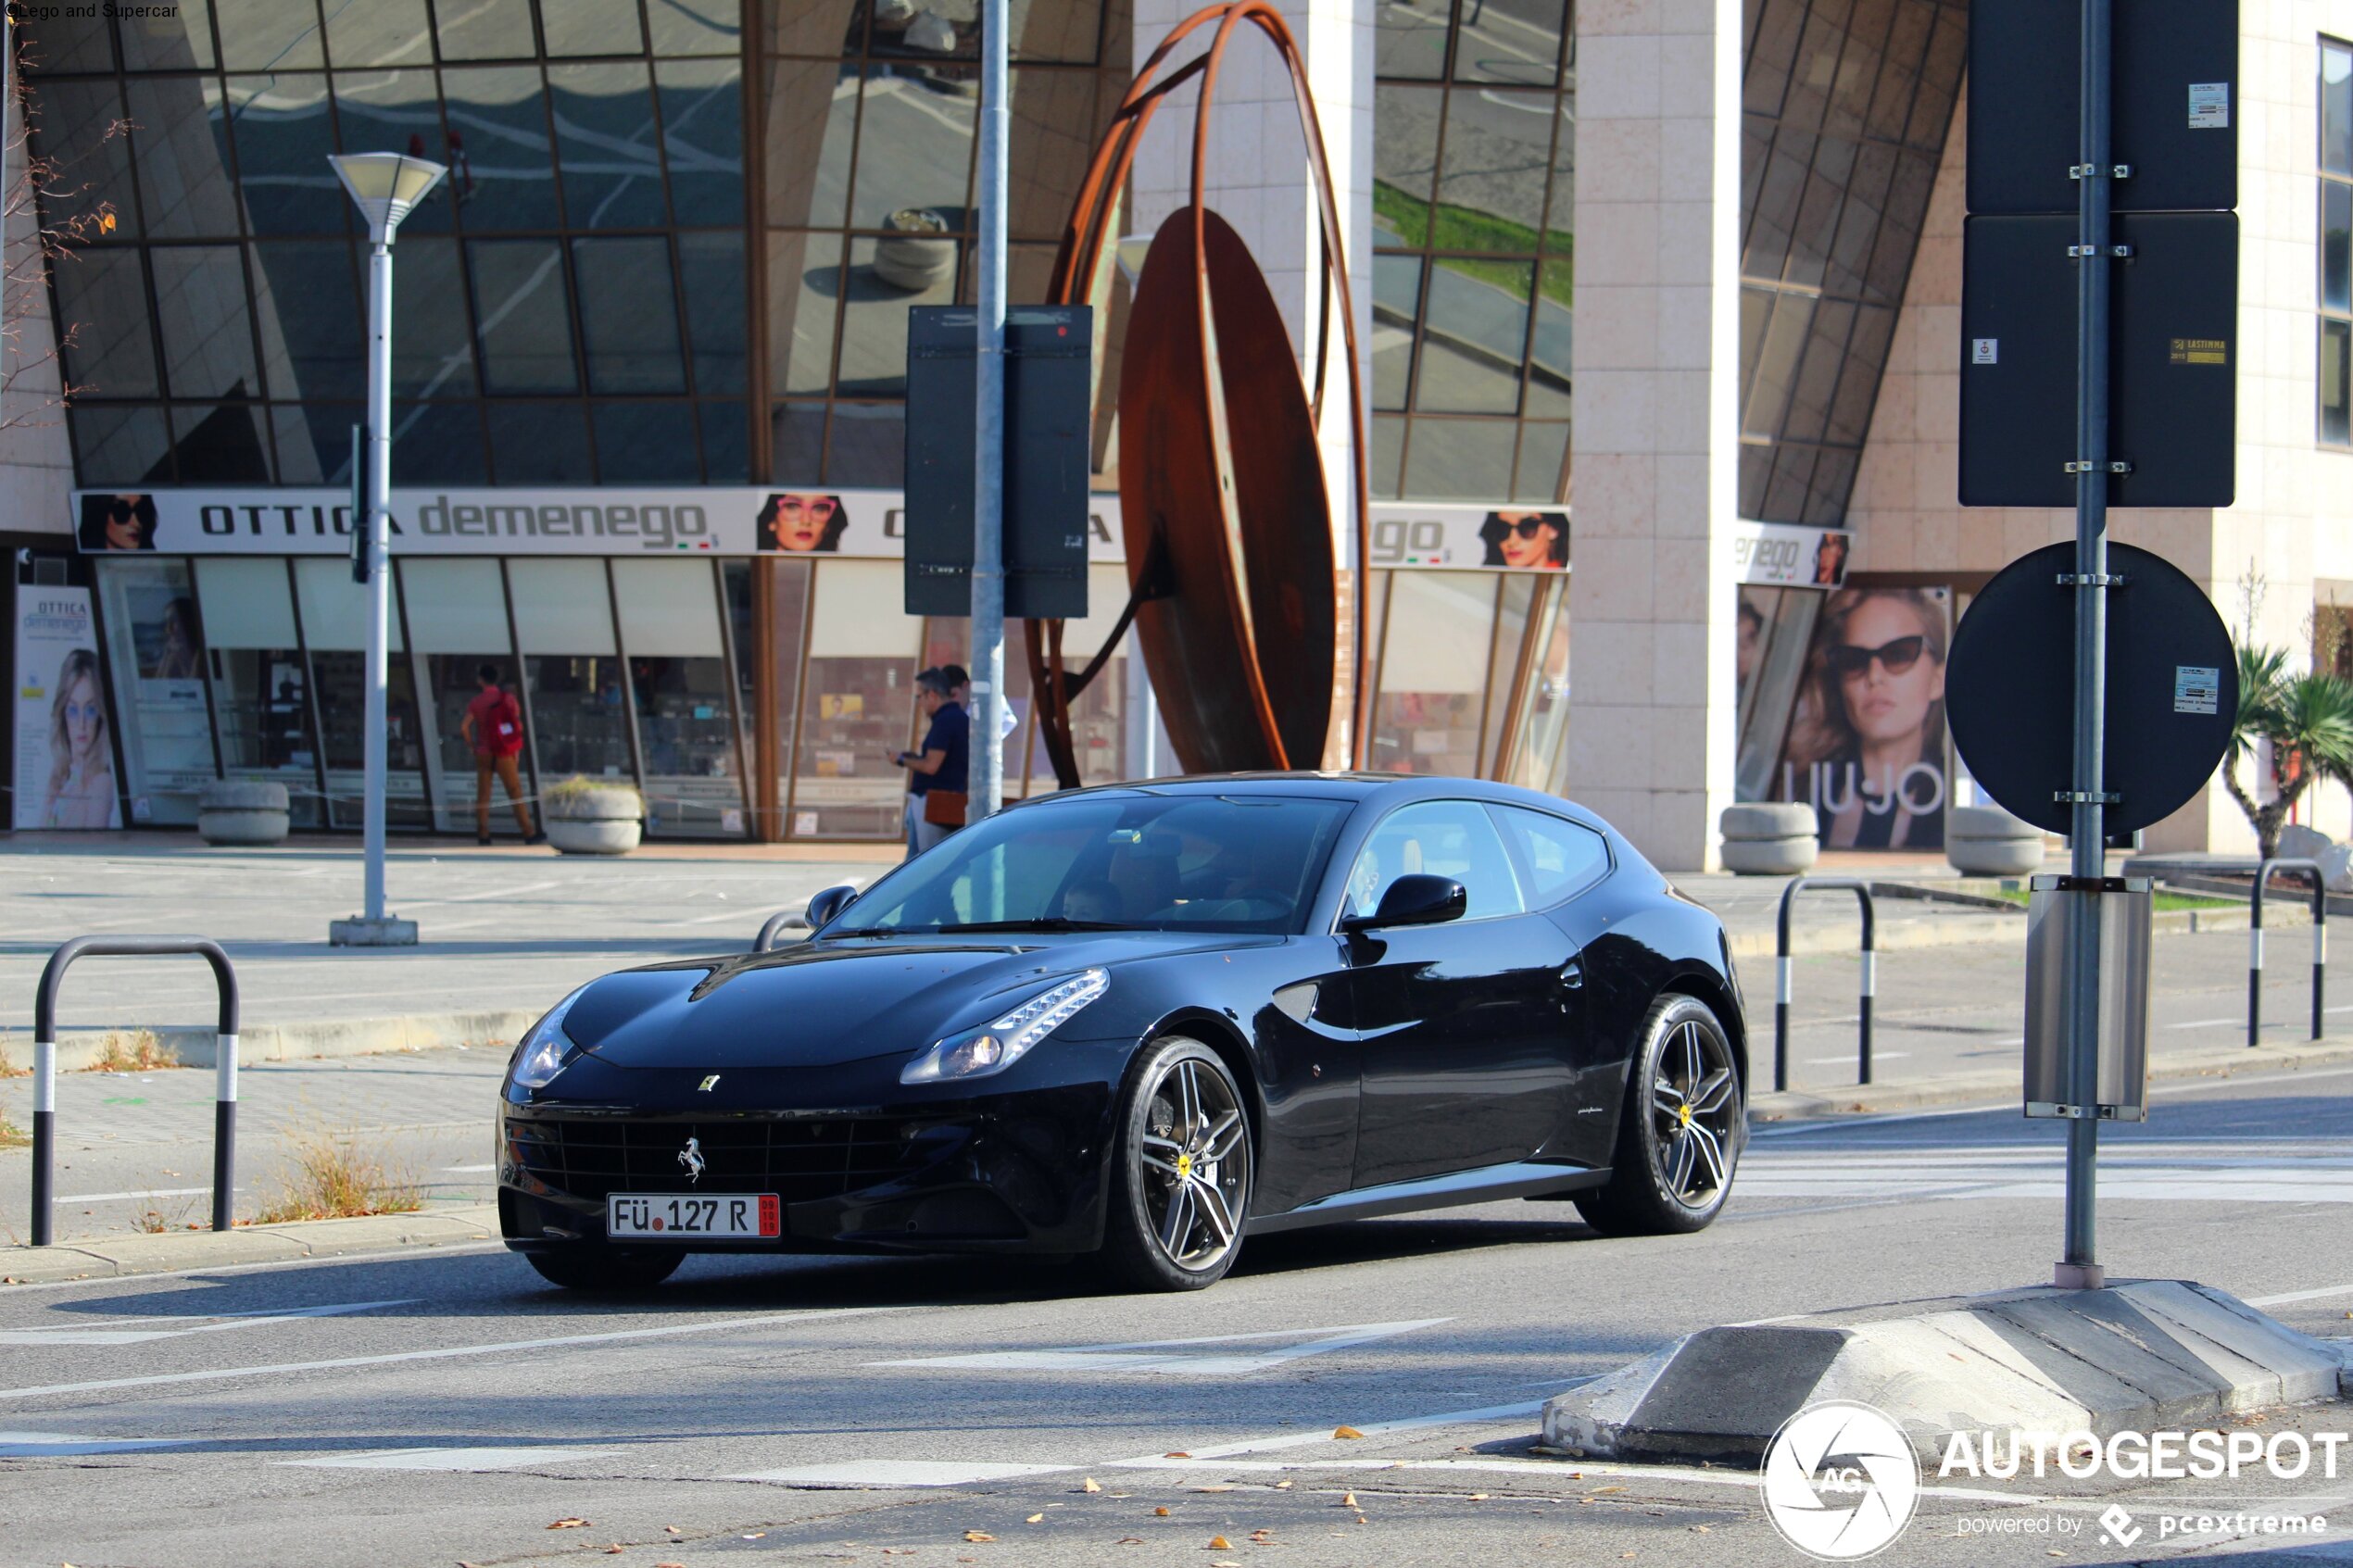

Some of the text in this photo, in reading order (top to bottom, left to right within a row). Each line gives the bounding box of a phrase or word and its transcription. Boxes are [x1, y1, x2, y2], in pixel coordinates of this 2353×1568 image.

[201, 495, 707, 549] OTTIC demenego
[39, 602, 86, 614] OTTICA
[761, 1200, 774, 1210] 09
[615, 1199, 749, 1232] FÜ 127 R
[762, 1211, 774, 1221] 10
